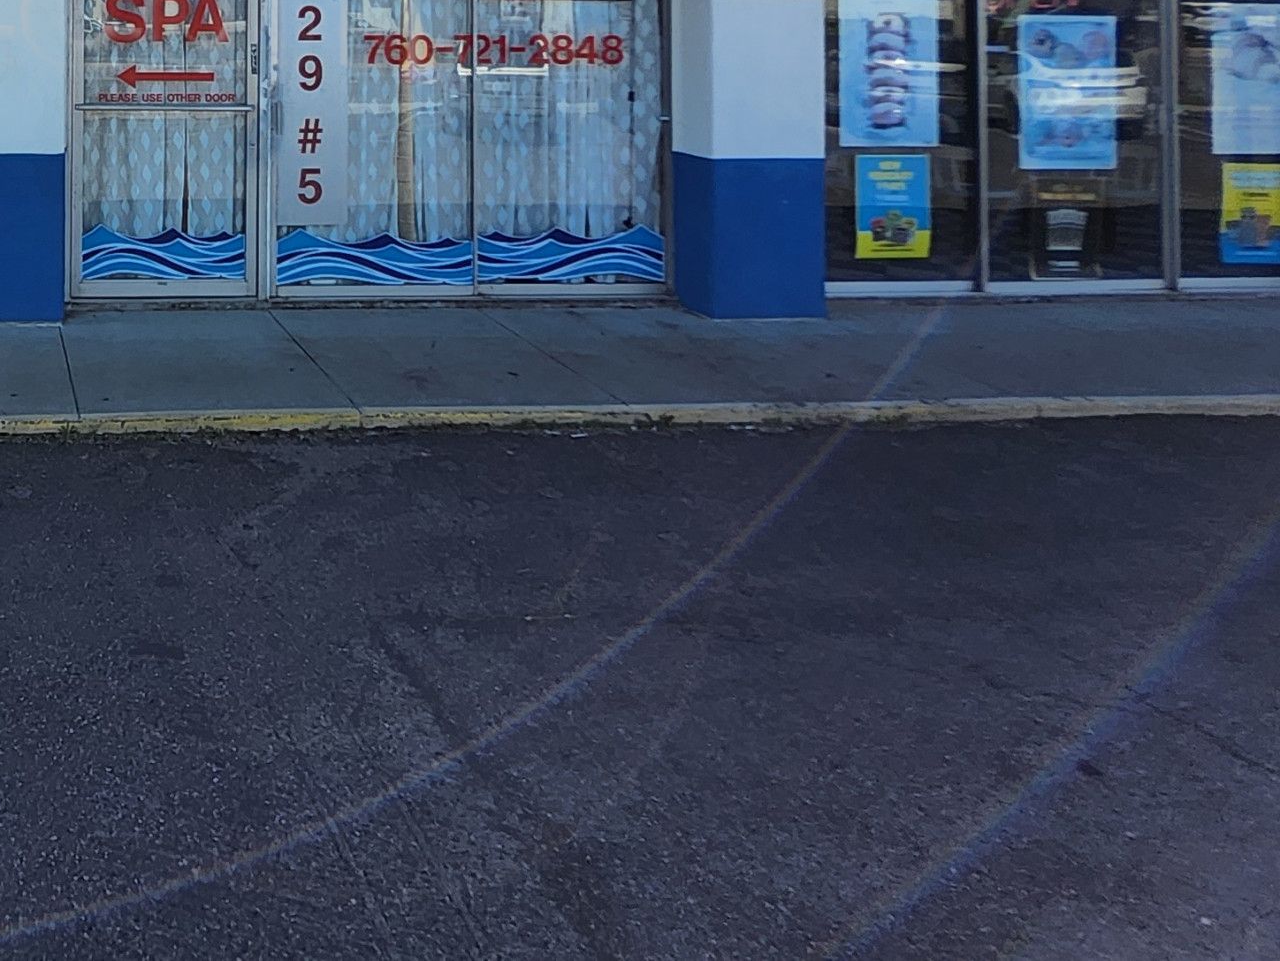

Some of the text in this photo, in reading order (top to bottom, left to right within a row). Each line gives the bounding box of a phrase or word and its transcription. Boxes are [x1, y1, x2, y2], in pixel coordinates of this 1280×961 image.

[363, 33, 625, 66] 760-721-2848
[98, 93, 236, 103] PLEASE USE OTHER DOOR
